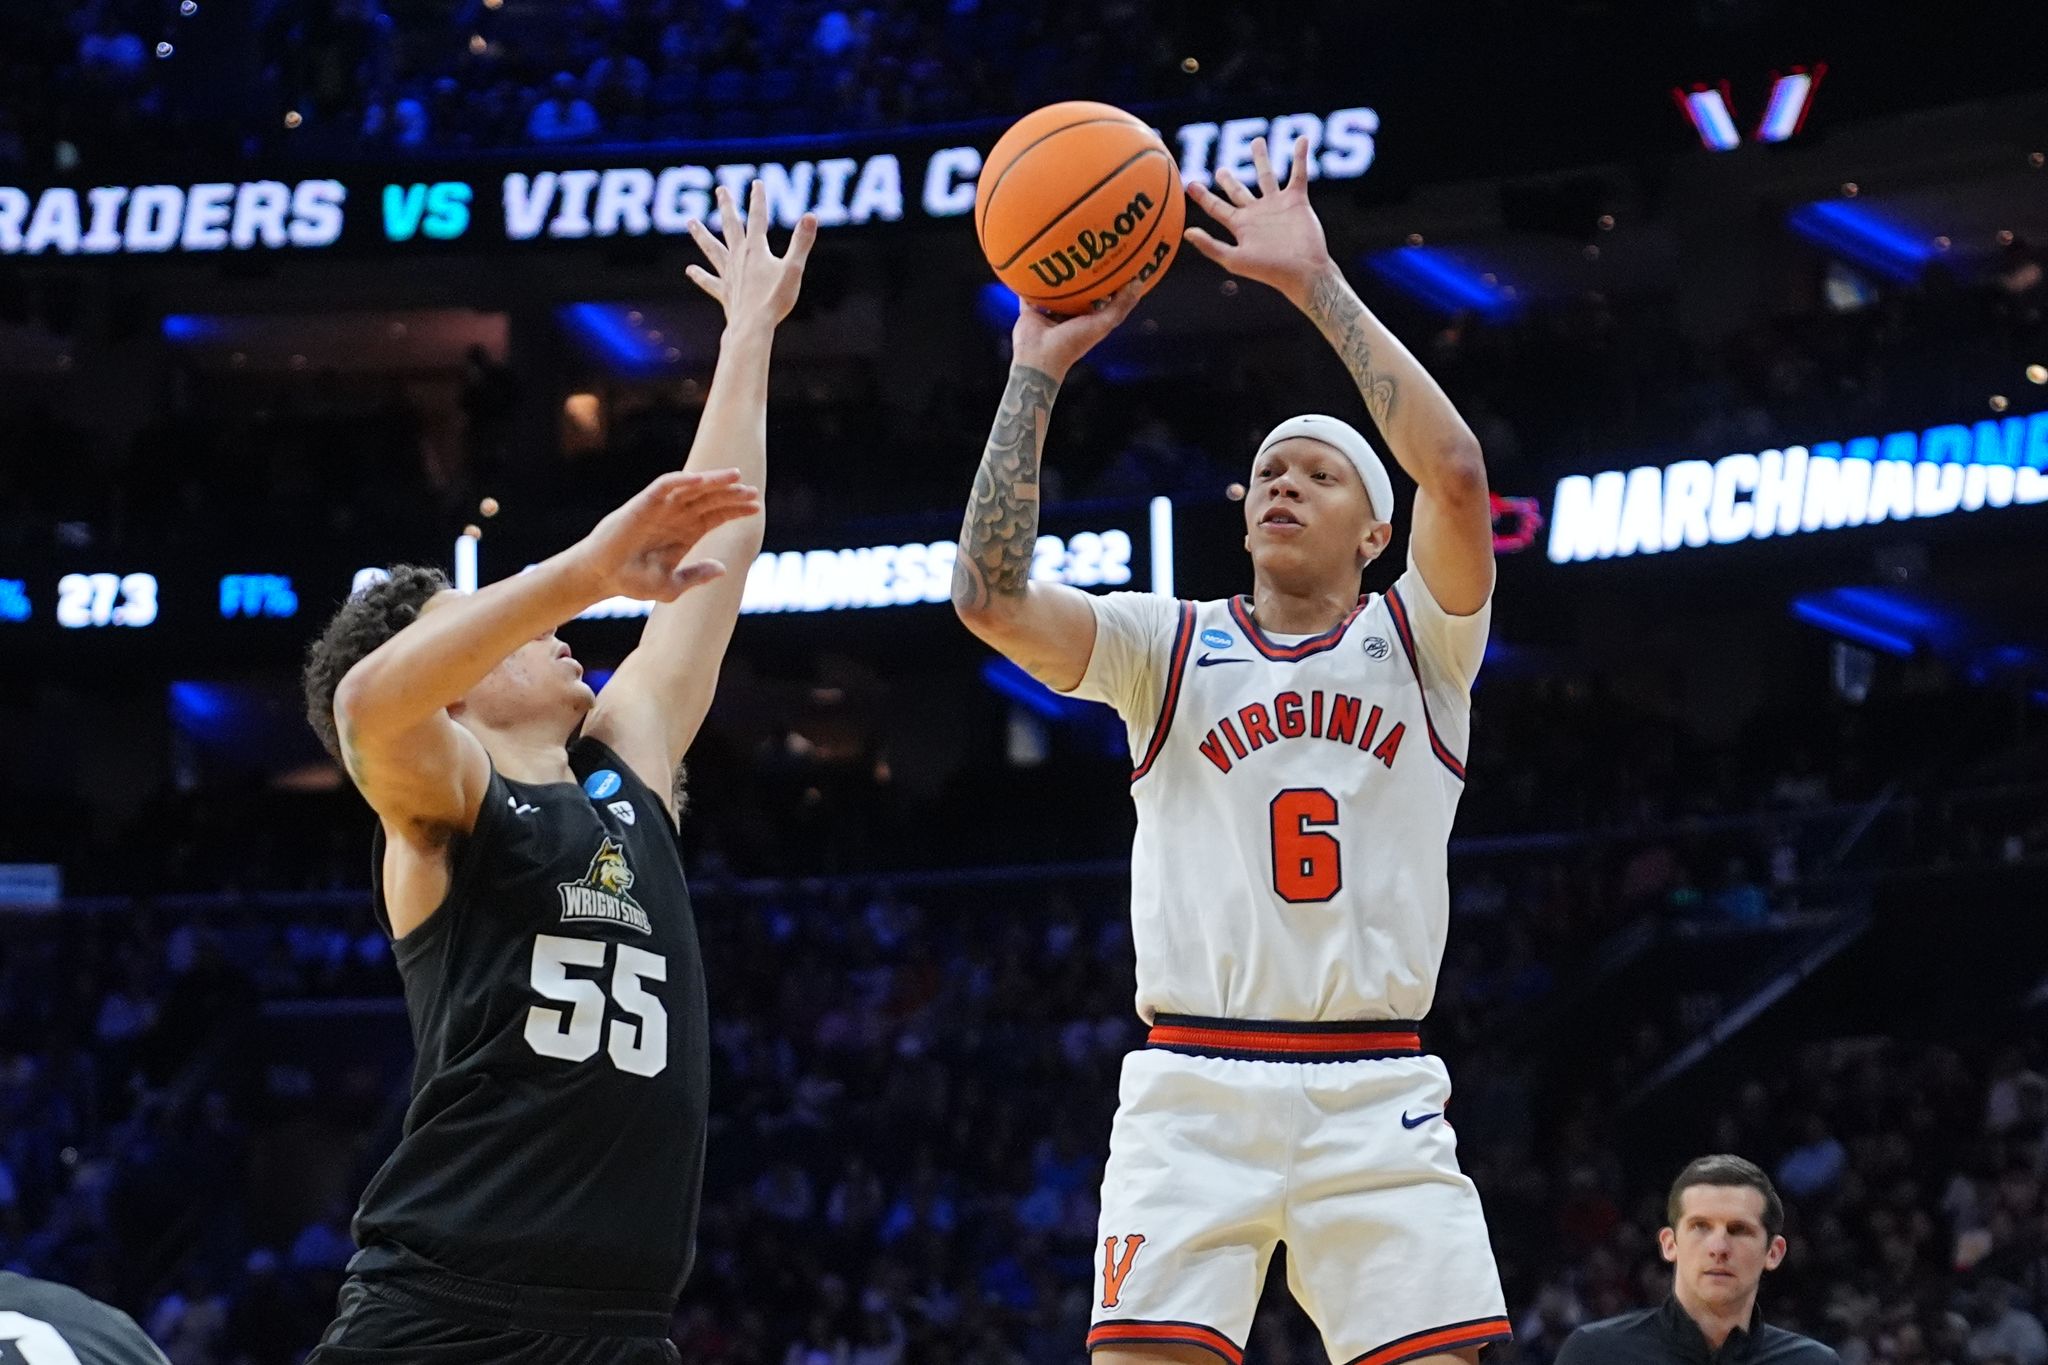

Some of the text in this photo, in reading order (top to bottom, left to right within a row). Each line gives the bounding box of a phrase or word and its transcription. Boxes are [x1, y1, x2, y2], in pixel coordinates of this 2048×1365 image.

[381, 181, 473, 241] VS
[502, 154, 903, 240] VIRGINIA
[1028, 192, 1154, 287] Wilson
[57, 572, 158, 628] 27.3
[1198, 690, 1406, 774] VIRGINIA
[1270, 787, 1342, 903] 6
[564, 886, 621, 919] WRIGHT
[524, 934, 667, 1077] 55
[1102, 1234, 1145, 1308] V
